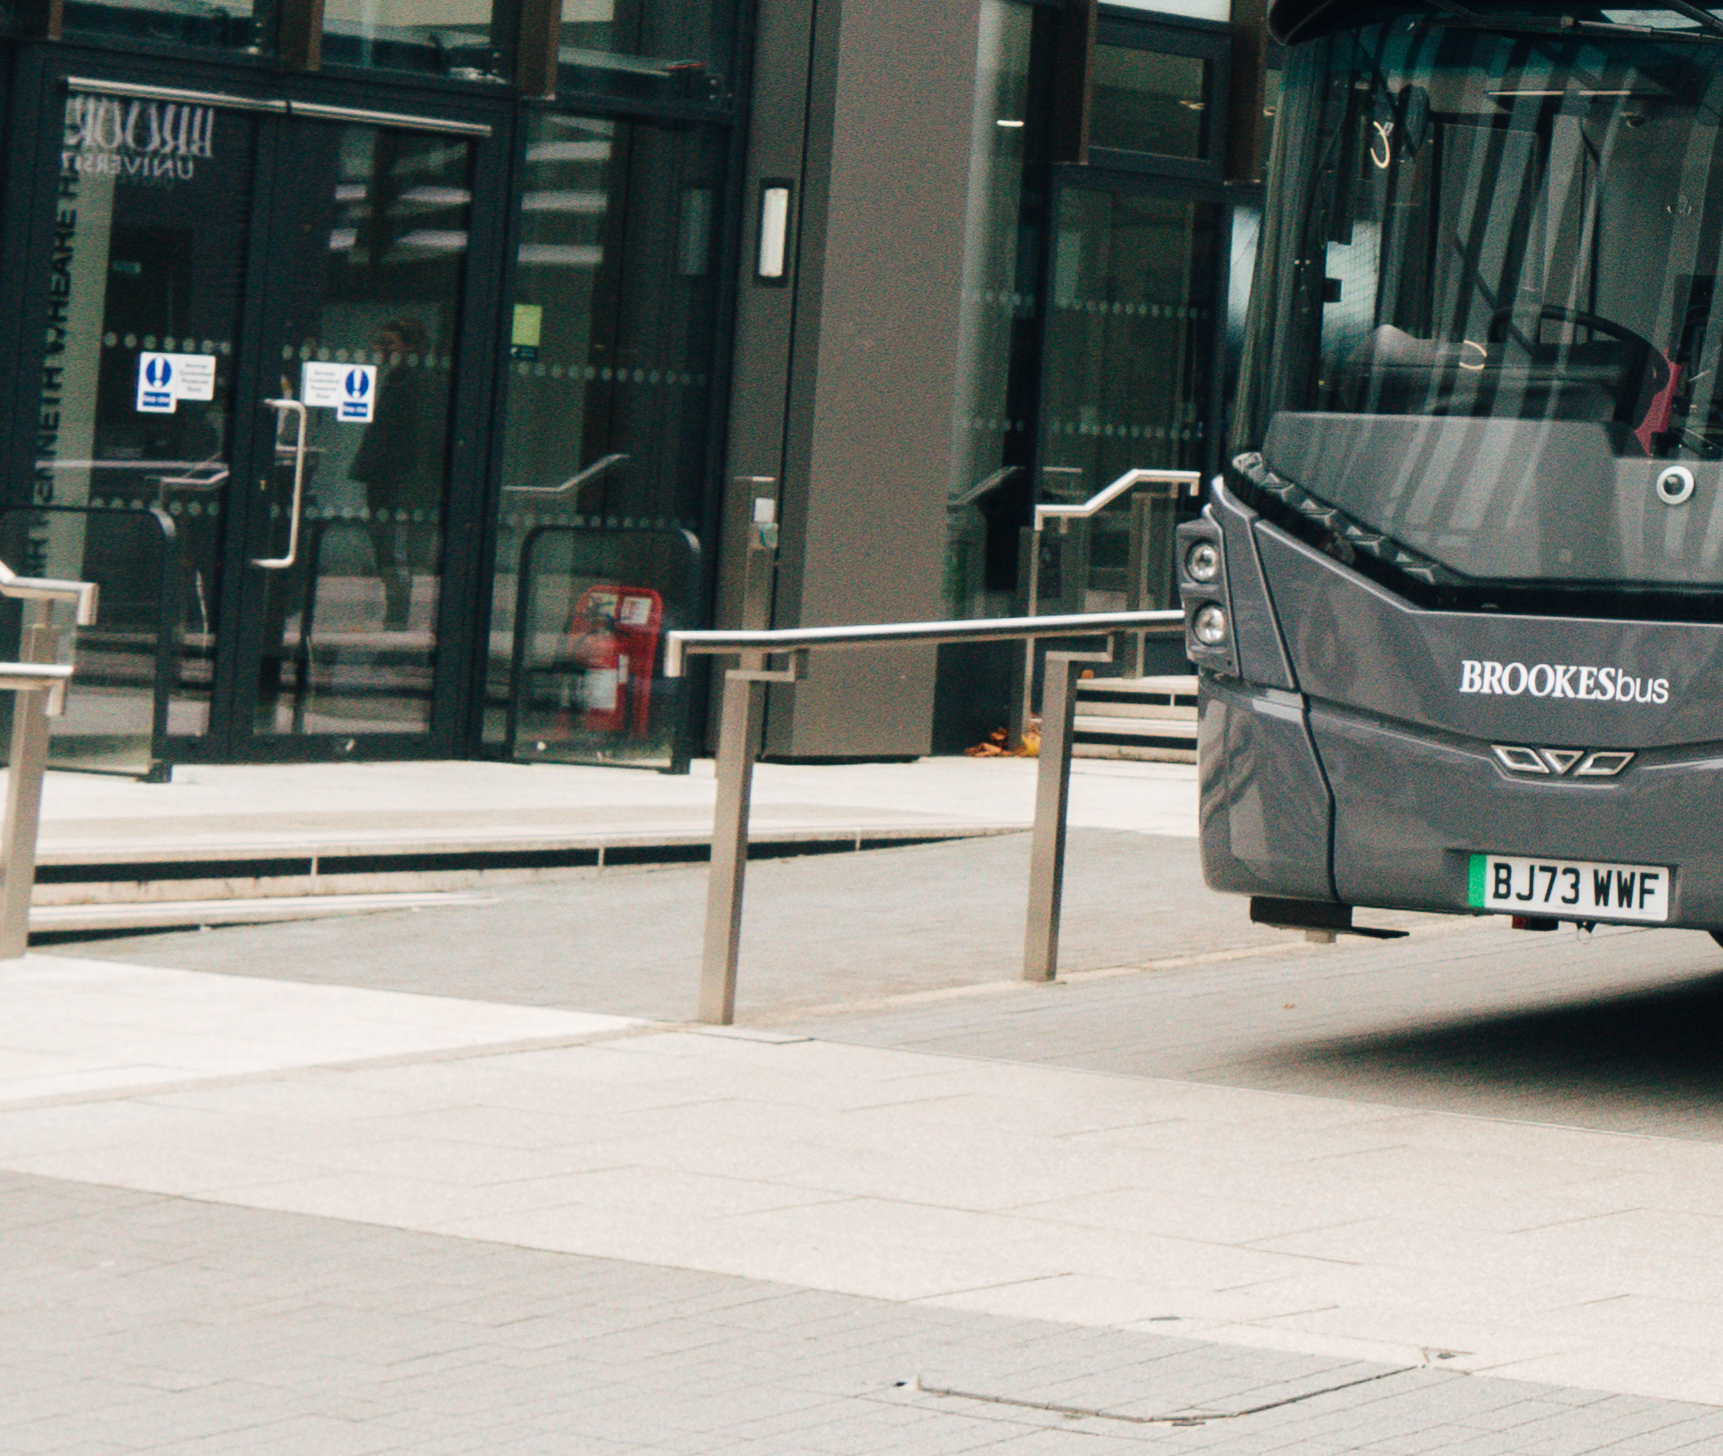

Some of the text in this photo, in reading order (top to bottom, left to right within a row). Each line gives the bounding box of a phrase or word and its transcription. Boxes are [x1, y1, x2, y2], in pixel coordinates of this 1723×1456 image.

[1459, 660, 1670, 704] BROOKESbus
[1492, 862, 1660, 909] BJ73 WWF
